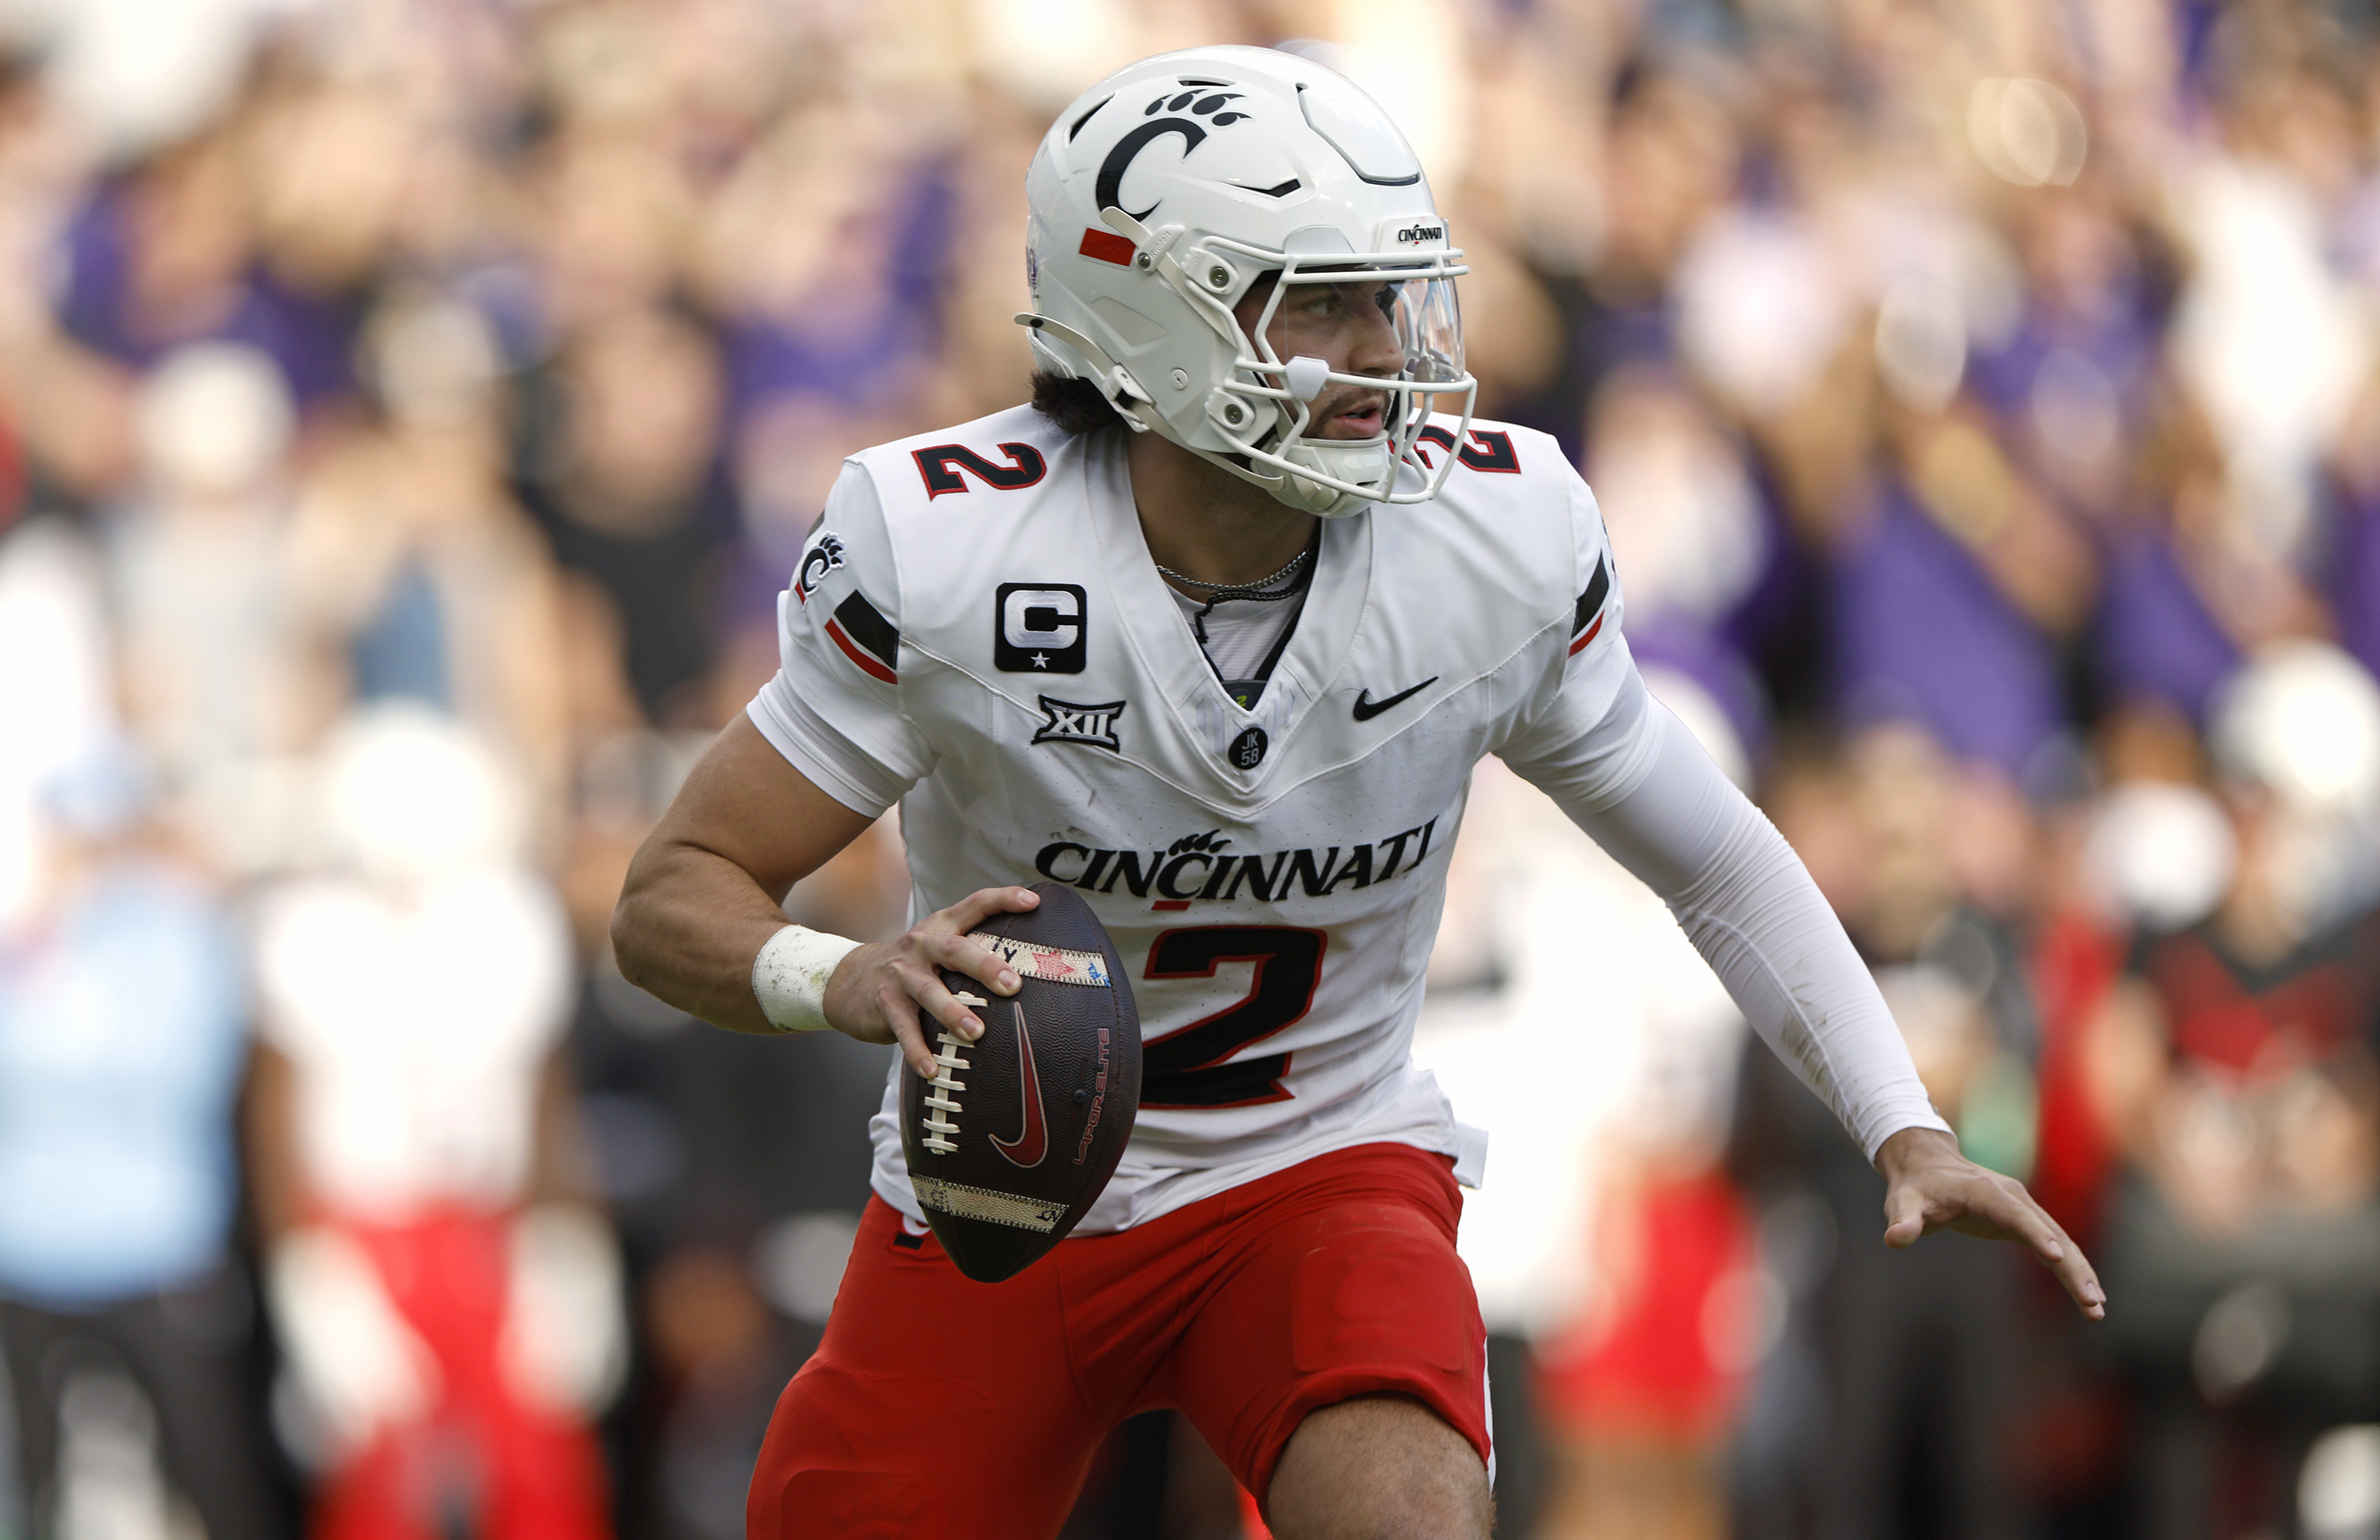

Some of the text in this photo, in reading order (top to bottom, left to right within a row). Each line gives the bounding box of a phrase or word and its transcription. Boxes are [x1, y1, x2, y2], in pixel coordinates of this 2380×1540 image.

[911, 442, 1047, 501] 2
[1388, 424, 1522, 474] 2
[1003, 590, 1079, 649] C
[1049, 709, 1109, 736] XII
[1242, 732, 1259, 750] JK
[1240, 747, 1260, 766] 58
[1035, 816, 1439, 902] CINCINNATI
[1139, 924, 1329, 1110] 2
[1073, 1027, 1109, 1165] VAPOR ELITE
